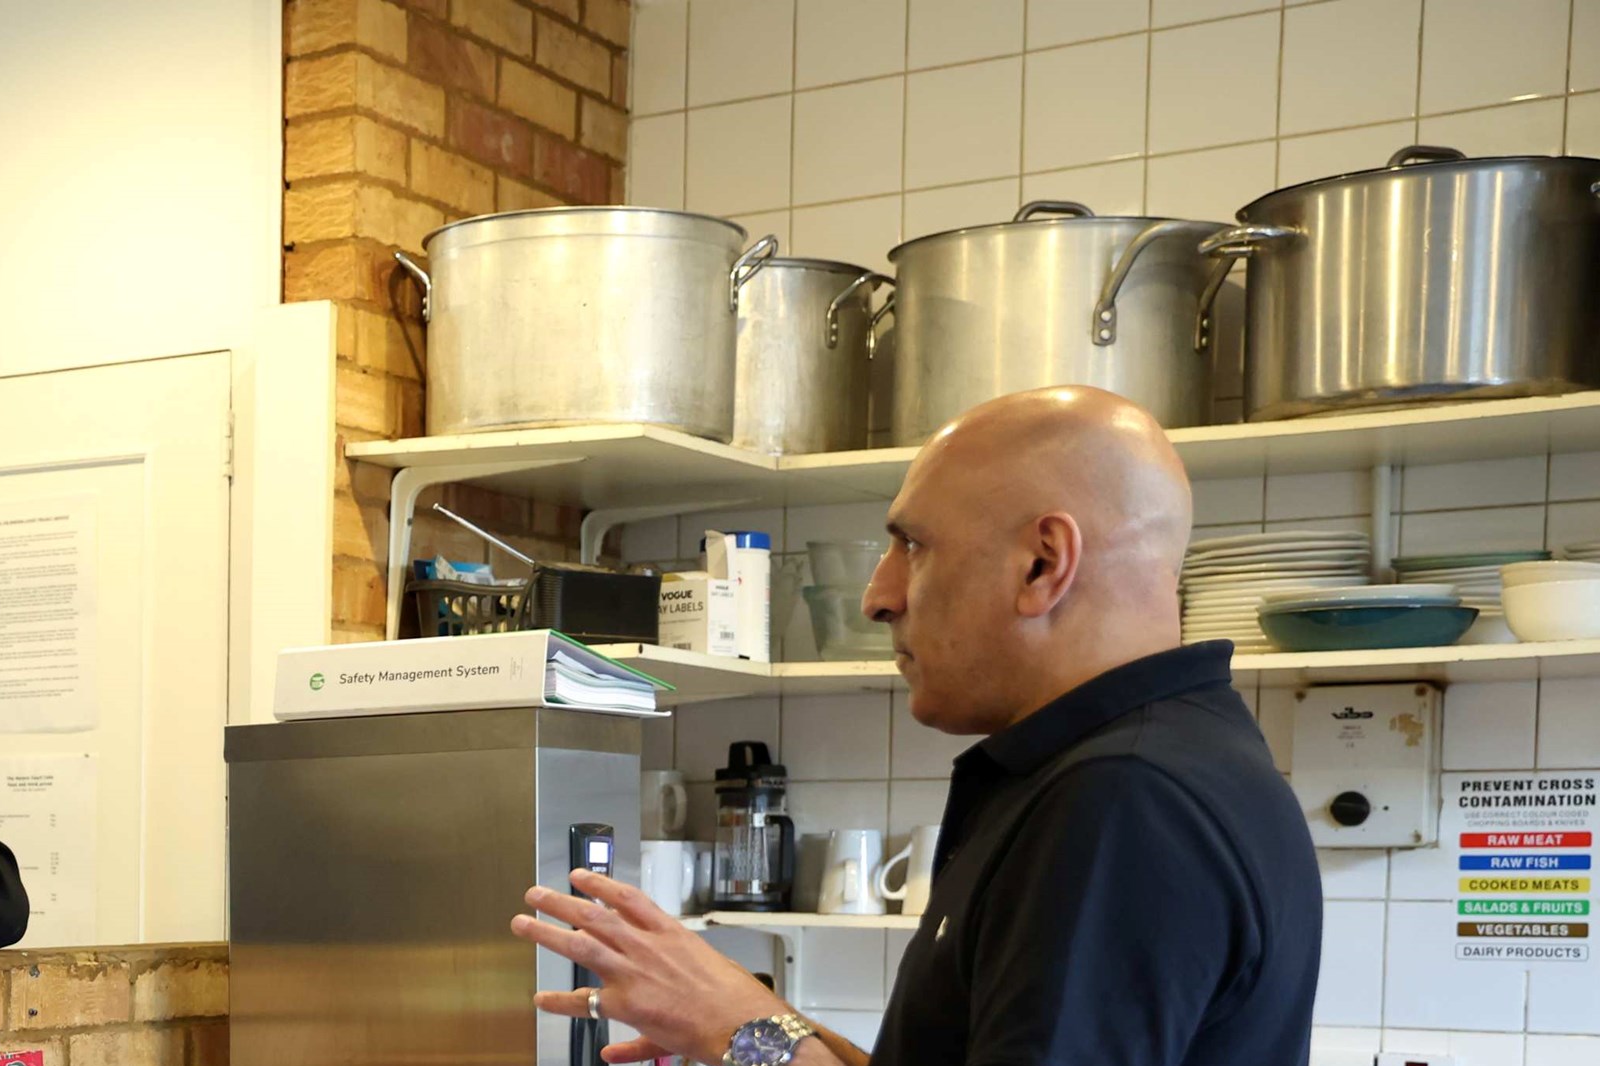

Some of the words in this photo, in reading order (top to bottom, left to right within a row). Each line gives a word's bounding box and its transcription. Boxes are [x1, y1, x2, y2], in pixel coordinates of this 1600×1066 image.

[661, 590, 693, 600] VOGUE
[669, 601, 704, 614] LABELS
[339, 673, 376, 685] Safety
[378, 667, 452, 682] Management
[456, 664, 500, 678] System
[1461, 780, 1534, 791] PREVENT
[1538, 779, 1594, 790] CROSS
[1459, 794, 1596, 808] CONTAMINATION
[1521, 810, 1557, 818] COLOUR
[1488, 835, 1519, 846] RAW
[1523, 834, 1563, 845] MEAT
[1491, 858, 1522, 868] RAW
[1526, 857, 1558, 868] FISH
[1469, 880, 1528, 890] COOKED
[1532, 880, 1579, 890] MEATS
[1464, 902, 1517, 913] SALADS
[1520, 902, 1530, 913] &
[1533, 902, 1582, 913] FRUITS
[1476, 924, 1568, 936] VEGETABLES
[1463, 947, 1502, 957] DAIRY
[1506, 947, 1580, 958] PRODUCTS
